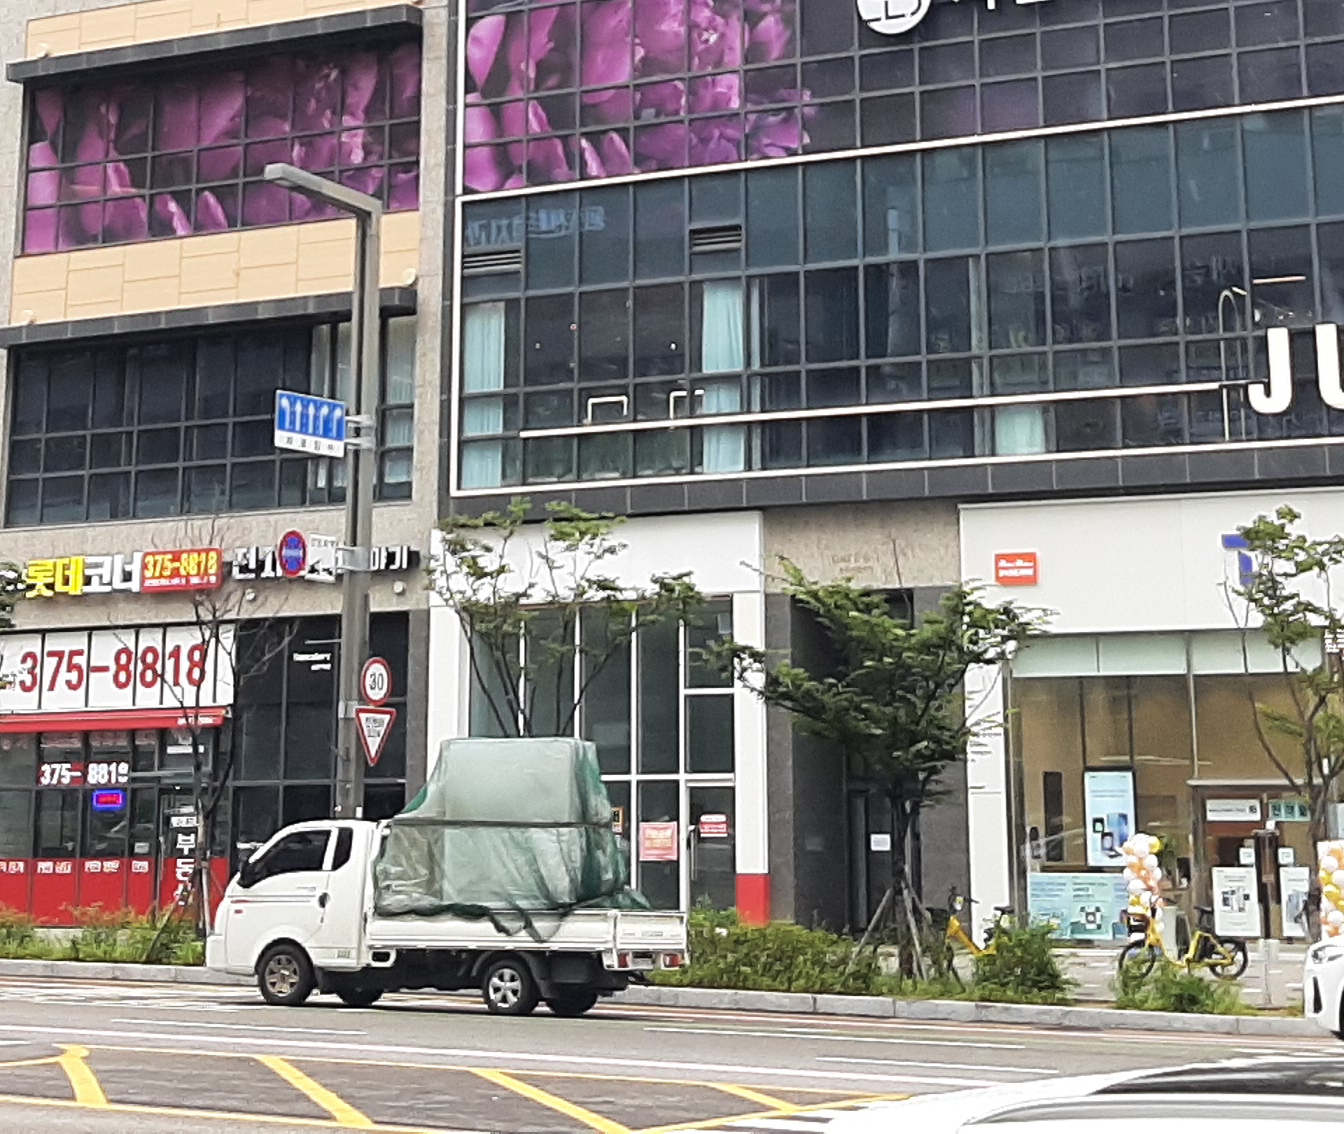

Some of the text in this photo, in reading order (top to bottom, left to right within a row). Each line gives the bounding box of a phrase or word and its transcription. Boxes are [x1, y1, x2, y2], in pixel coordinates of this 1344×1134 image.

[23, 551, 144, 599] 롯데코너
[143, 550, 219, 578] 375-8818
[19, 643, 208, 694] 375-8818
[369, 672, 385, 691] 30
